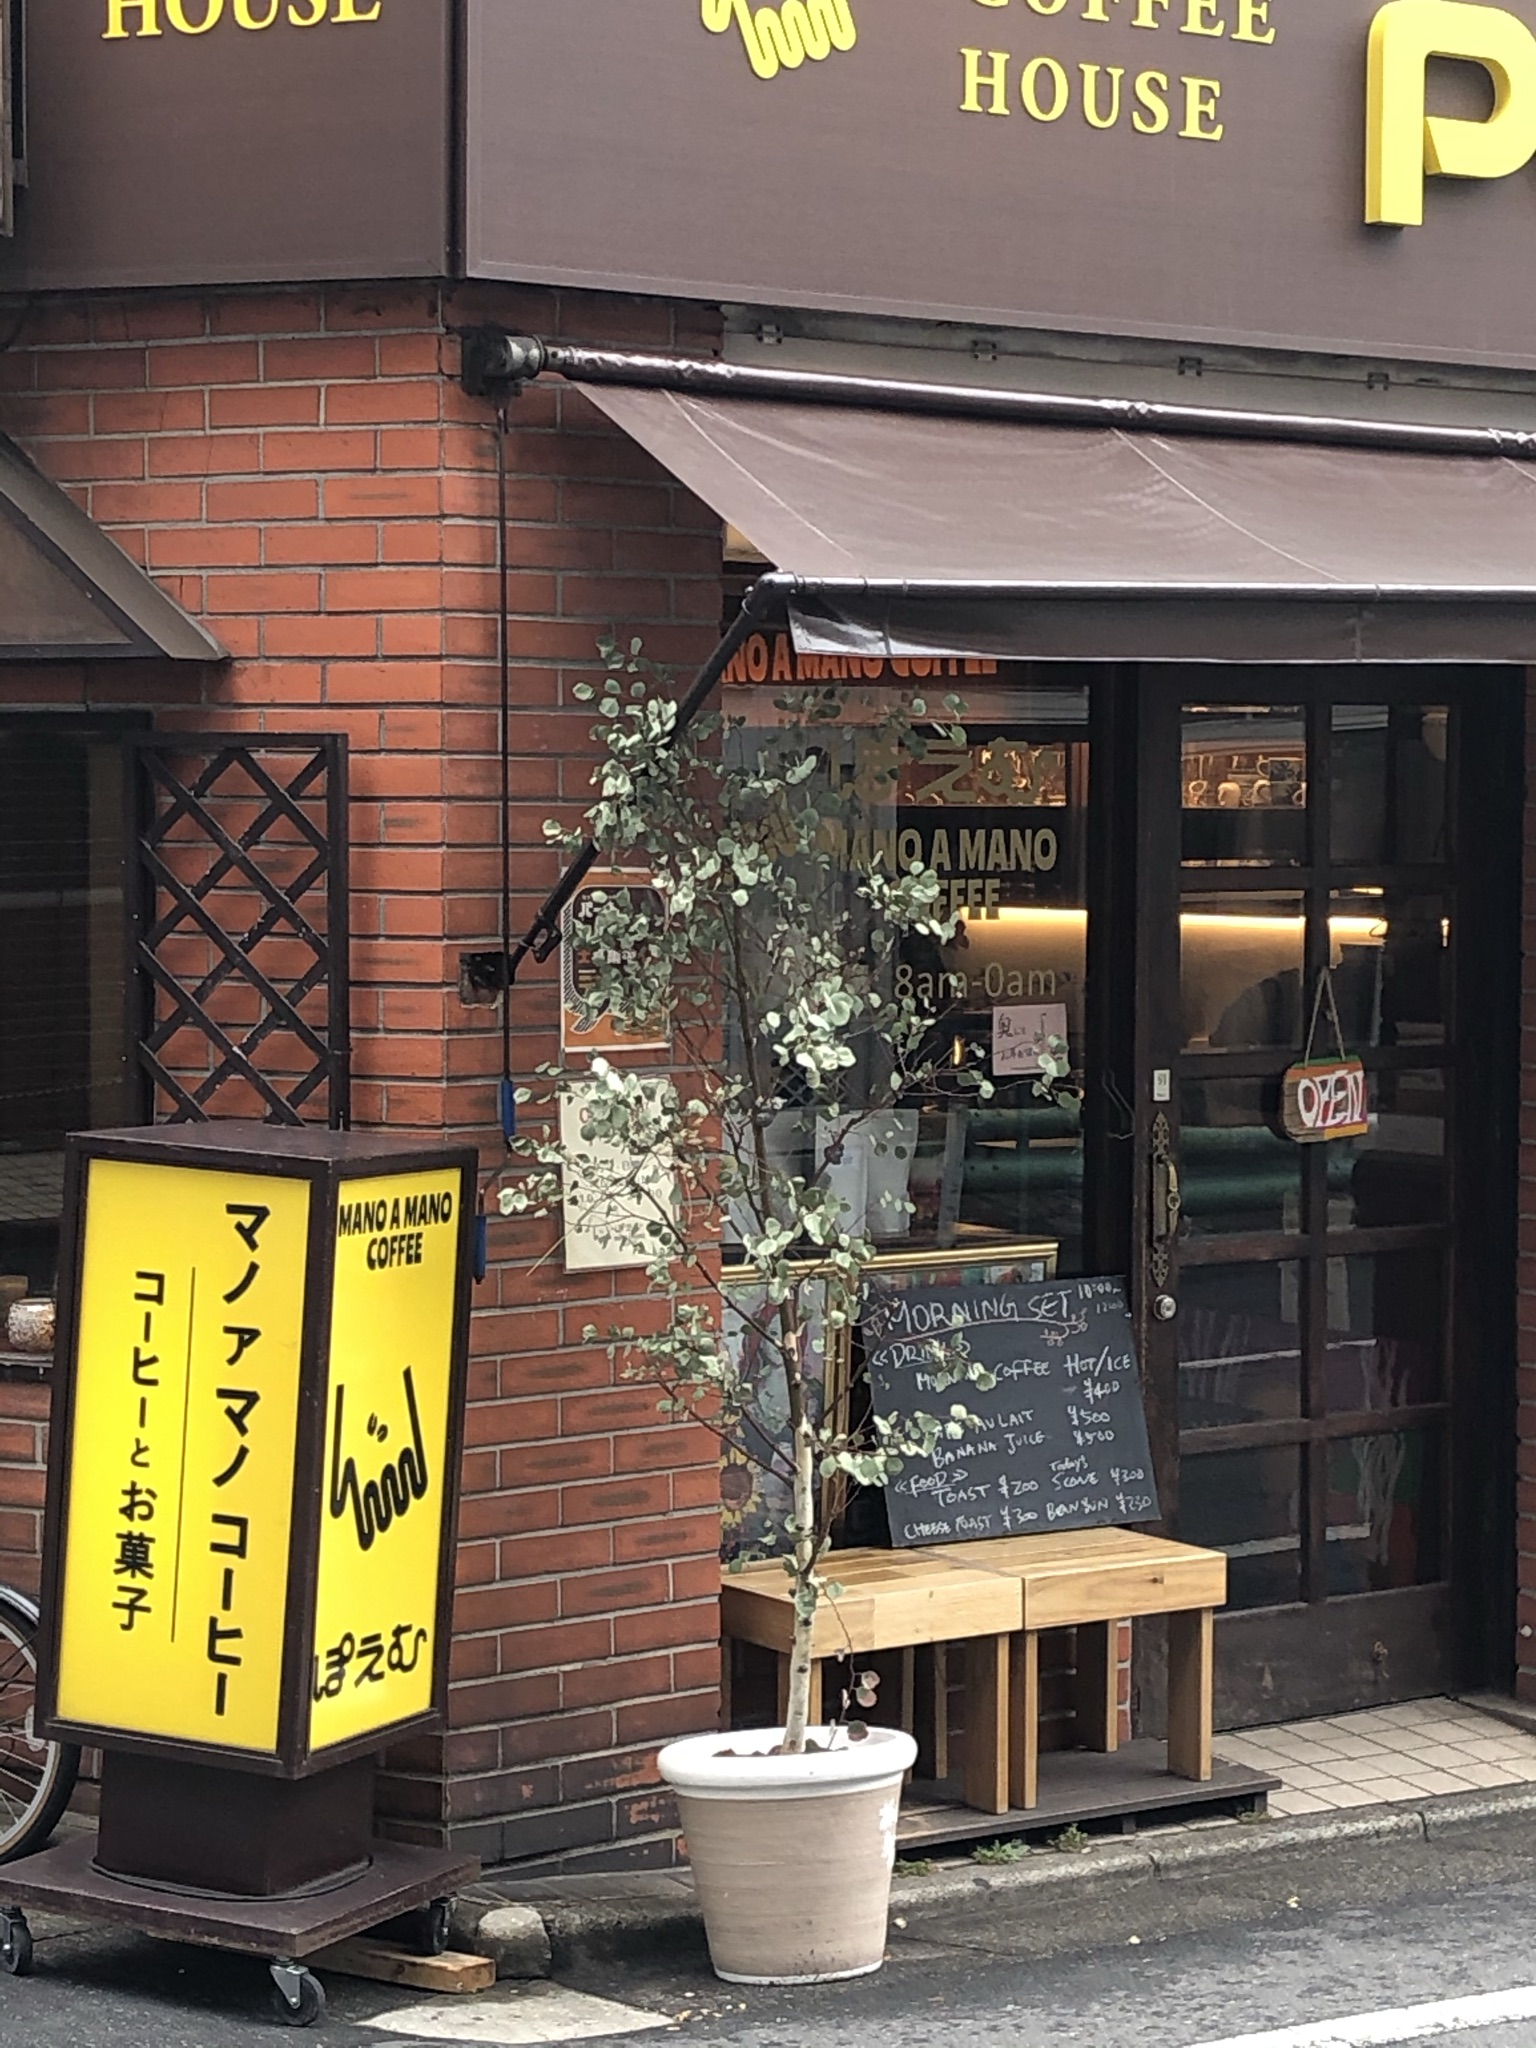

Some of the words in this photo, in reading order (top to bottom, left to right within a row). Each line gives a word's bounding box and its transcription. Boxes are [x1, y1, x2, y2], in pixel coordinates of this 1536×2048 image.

[959, 47, 1224, 141] HOUSE
[772, 633, 793, 681] A
[930, 828, 951, 871] A
[958, 828, 1058, 871] MANO
[1298, 1069, 1364, 1128] OPEN
[338, 1199, 387, 1237] MANO
[389, 1197, 400, 1230] A
[404, 1191, 452, 1229] MANO
[366, 1231, 423, 1271] COFFEE
[885, 1294, 1019, 1334] MORNING
[1028, 1290, 1072, 1319] SET
[993, 1359, 1052, 1382] COFFEE
[1067, 1405, 1111, 1427] ¥500
[112, 1269, 166, 1633] コーヒーとお菓子
[931, 1440, 998, 1469] BANANA
[1004, 1430, 1047, 1455] JUICE
[931, 1484, 992, 1508] TOAST
[1051, 1472, 1100, 1492] SCONE
[904, 1521, 952, 1540] CHEESE
[955, 1515, 993, 1533] TOAST
[313, 1623, 428, 1703] ぽえむ
